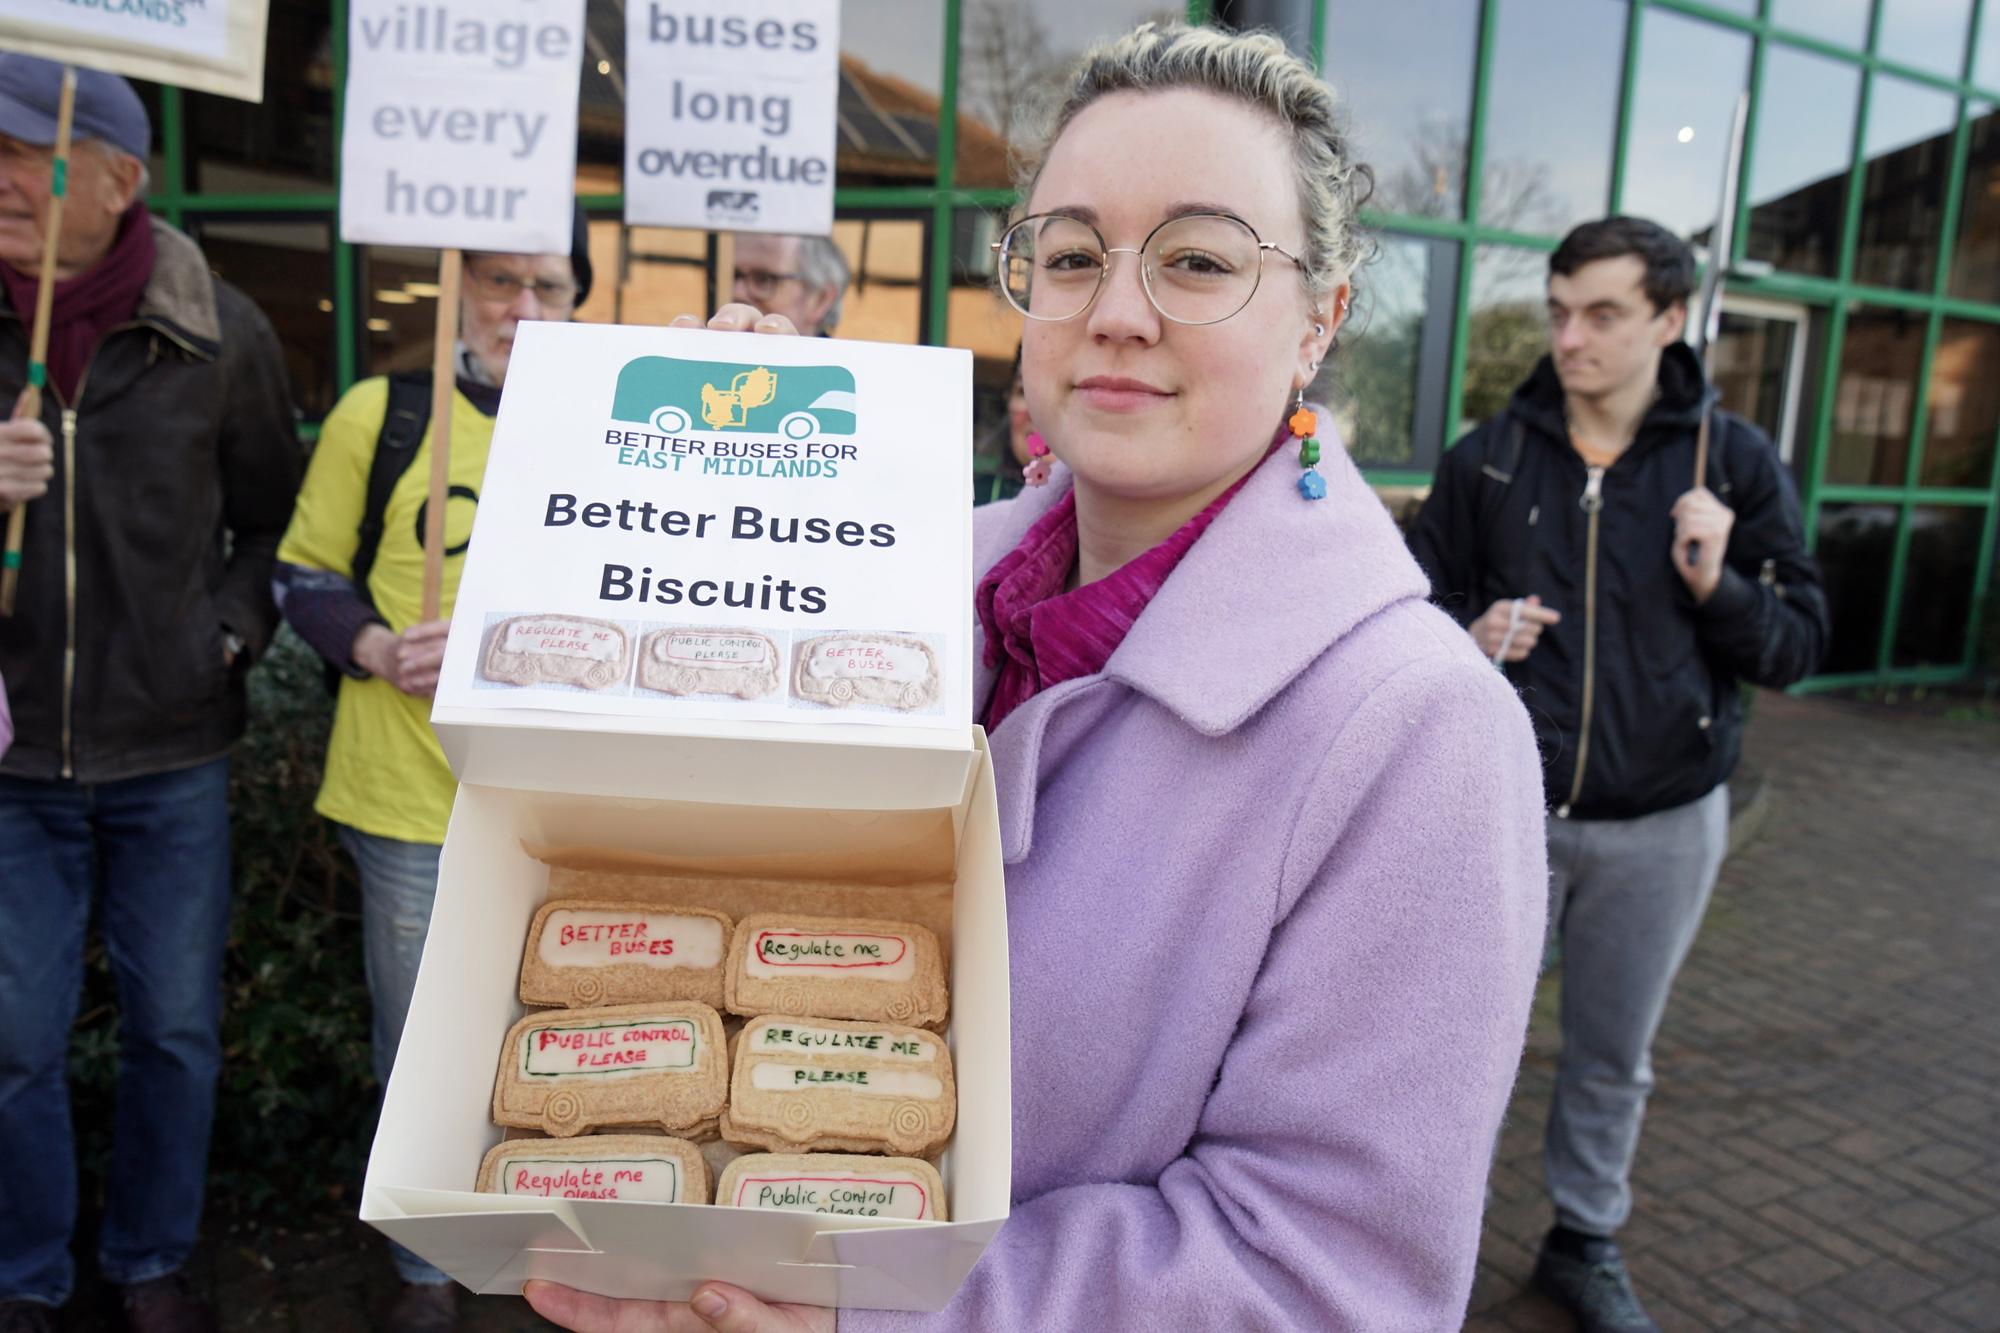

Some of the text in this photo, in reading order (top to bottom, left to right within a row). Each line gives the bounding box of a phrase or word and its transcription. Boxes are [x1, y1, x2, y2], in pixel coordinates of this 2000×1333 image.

[360, 4, 571, 70] village
[649, 3, 818, 51] buses
[672, 80, 791, 136] long
[372, 103, 548, 159] every
[638, 145, 827, 185] overdue
[384, 169, 527, 221] hour
[605, 430, 858, 460] BETTER BUSES FOR
[618, 447, 838, 478] EAST MIDLANDS
[544, 493, 896, 547] Better Buses
[599, 563, 827, 614] Biscuits
[515, 626, 610, 640] REGULATE ME
[540, 639, 591, 651] PLEASE
[671, 637, 711, 646] PUBLIC
[695, 651, 738, 659] PLEASE
[826, 648, 885, 659] BETTER
[848, 659, 895, 671] BUSES
[560, 922, 648, 946] BETTER
[610, 939, 673, 956] BUSES
[762, 939, 882, 960] Regulate me
[539, 1028, 690, 1051] PUBLIC CONTROL
[764, 1028, 920, 1055] REGULATE ME
[577, 1050, 647, 1067] PLEASE
[794, 1070, 869, 1085] PLEASE
[516, 1167, 643, 1196] Regulate me
[759, 1184, 818, 1206] Public
